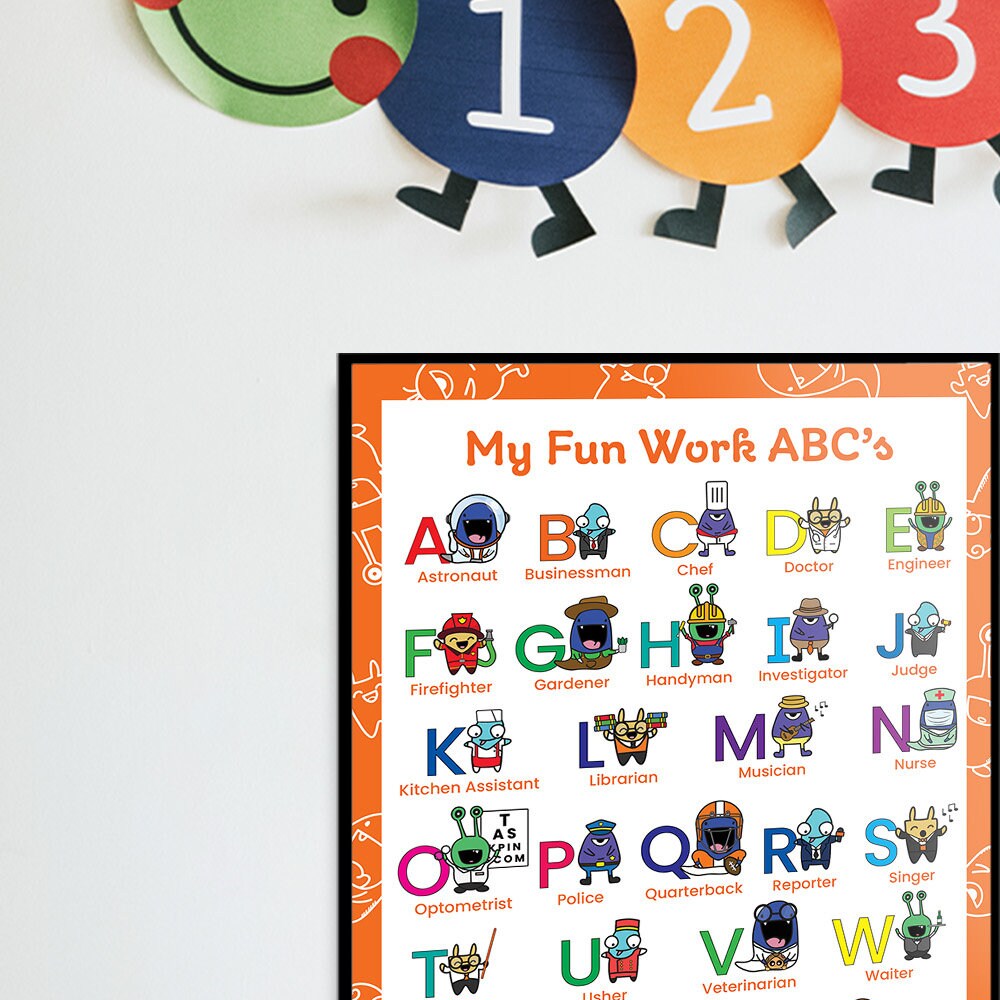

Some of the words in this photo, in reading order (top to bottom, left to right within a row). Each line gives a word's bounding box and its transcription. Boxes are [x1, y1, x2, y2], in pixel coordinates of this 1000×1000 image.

[467, 0, 554, 134] 1
[664, 0, 773, 132] 2
[898, 0, 977, 98] 3
[466, 430, 531, 476] My
[548, 430, 627, 465] Fun
[638, 427, 756, 464] Work
[404, 517, 450, 565] A
[539, 514, 576, 561] B
[651, 510, 699, 559] C
[766, 509, 807, 556] D
[885, 507, 912, 553] E
[417, 569, 498, 583] Astronaut
[525, 566, 631, 580] Businessman
[677, 562, 714, 576] Chef
[784, 560, 834, 573] Doctor
[887, 557, 951, 573] Engineer
[405, 629, 436, 678] F
[515, 624, 565, 672] G
[640, 621, 680, 668] H
[767, 616, 790, 663] I
[876, 613, 904, 659] J
[410, 682, 492, 698] Firefighter
[534, 676, 610, 691] Gardener
[646, 672, 733, 688] Handyman
[758, 667, 848, 683] Investigator
[891, 664, 938, 679] Judge
[427, 727, 467, 776] K
[579, 721, 605, 769] L
[715, 713, 765, 762] M
[872, 705, 910, 754] N
[399, 781, 461, 797] Kitchen
[465, 777, 540, 793] Assistant
[589, 771, 658, 786] Librarian
[738, 764, 806, 779] Musician
[894, 758, 937, 770] Nurse
[499, 813, 510, 827] T
[865, 818, 898, 867] S
[398, 845, 450, 896] O
[539, 841, 575, 889] P
[641, 825, 691, 879] Q
[764, 827, 798, 874] R
[557, 892, 604, 906] Police
[645, 882, 743, 900] Quarterback
[772, 877, 837, 895] Reporter
[889, 870, 936, 885] Singer
[414, 898, 513, 918] Optometrist
[561, 938, 600, 986] U
[699, 928, 745, 976] V
[831, 915, 895, 966] W
[412, 949, 448, 998] T
[702, 977, 797, 995] Veterinarian
[865, 967, 914, 982] Waiter
